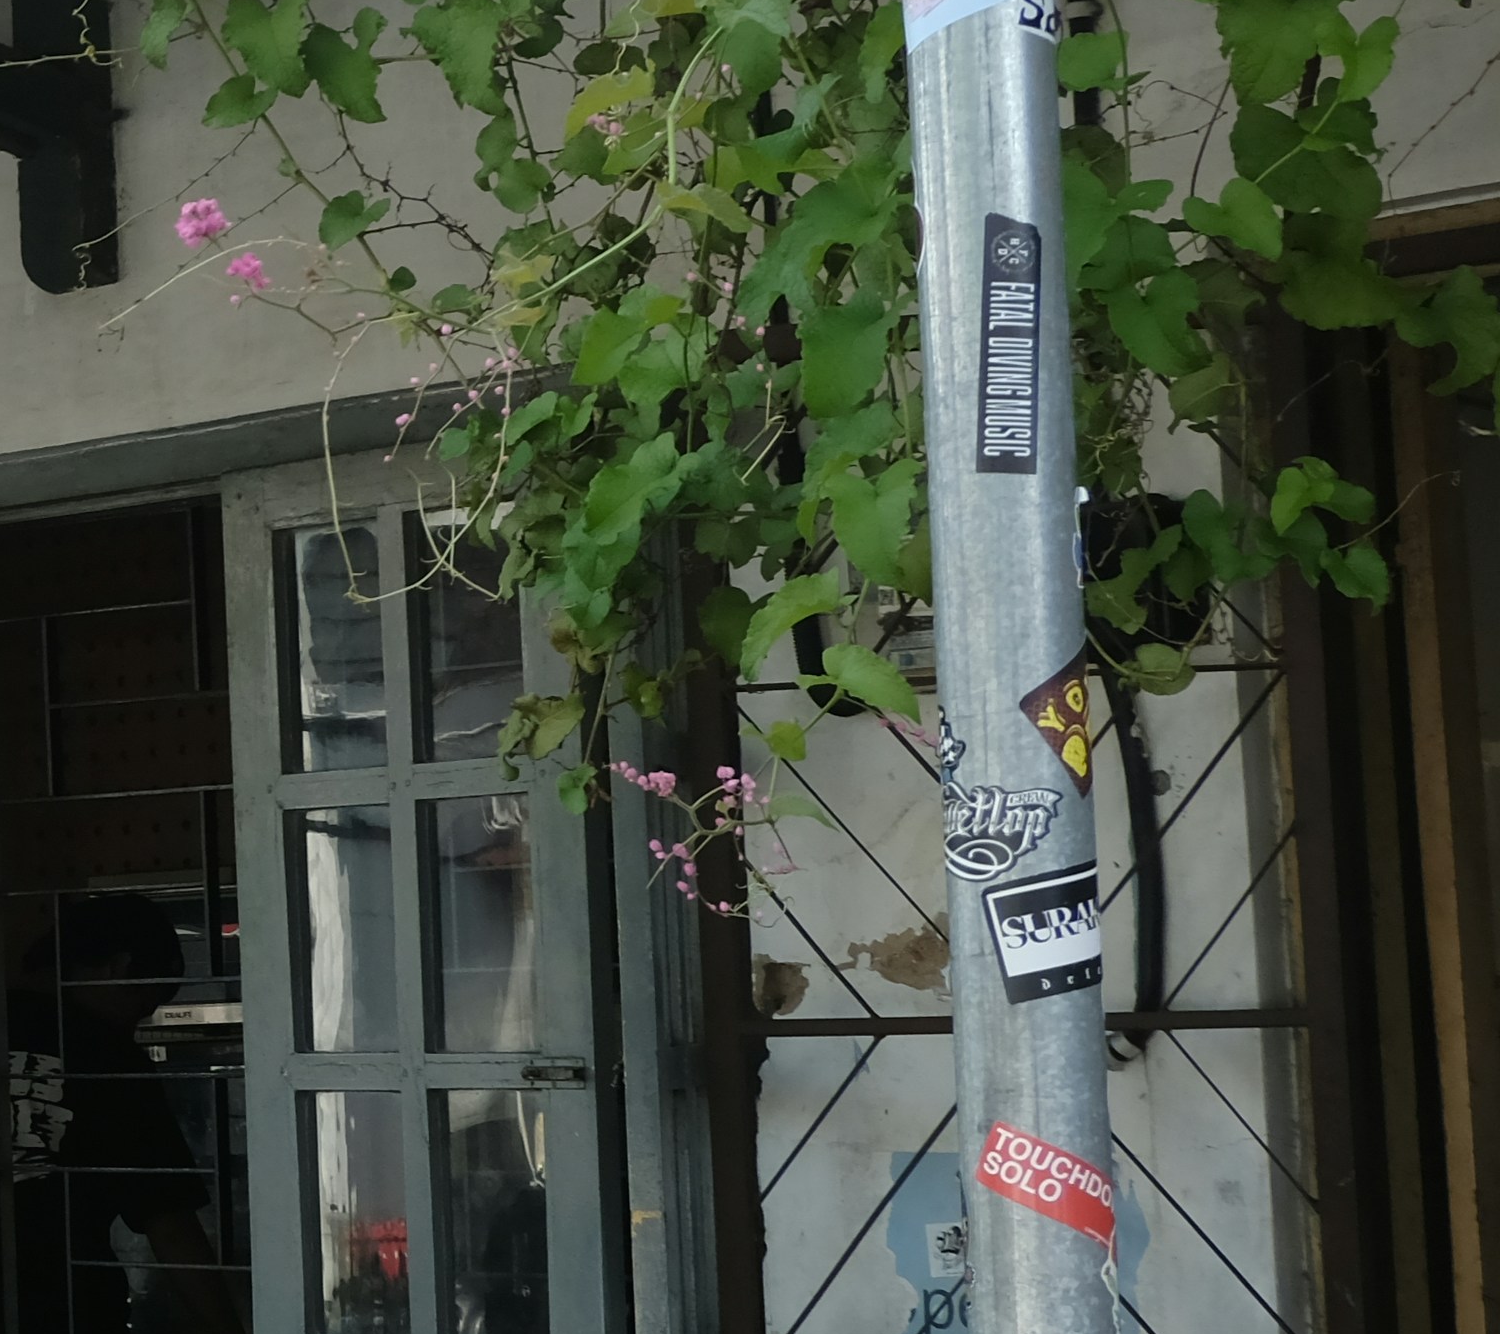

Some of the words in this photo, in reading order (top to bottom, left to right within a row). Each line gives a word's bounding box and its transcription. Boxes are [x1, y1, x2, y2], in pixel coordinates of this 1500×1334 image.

[988, 281, 1035, 331] FATAL
[986, 337, 1034, 396] DIVING
[983, 398, 1032, 457] MUSIC
[983, 1151, 1062, 1203] SOLO
